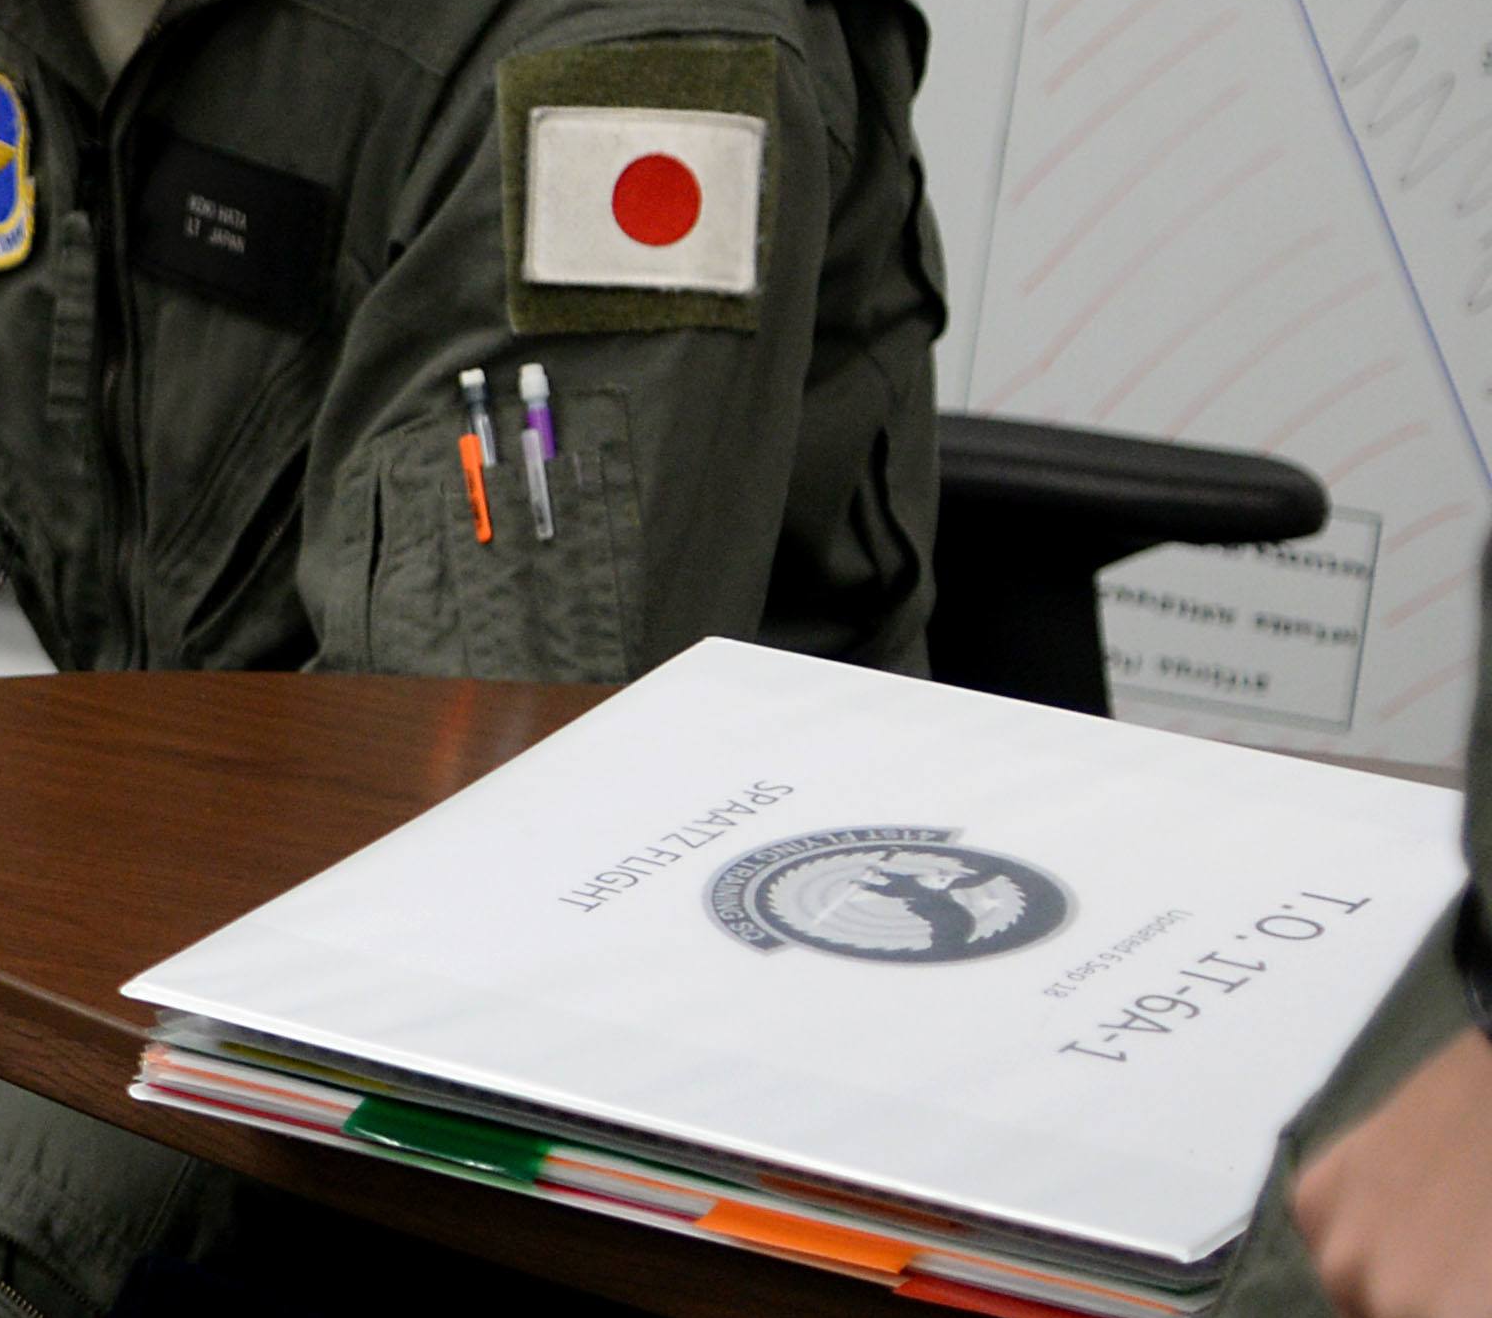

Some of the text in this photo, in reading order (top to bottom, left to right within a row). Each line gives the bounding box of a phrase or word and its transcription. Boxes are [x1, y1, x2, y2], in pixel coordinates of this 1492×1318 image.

[558, 780, 795, 913] SPAATZ FLIGHT
[754, 830, 856, 864] FLYING
[711, 857, 762, 923] TRAINING
[1113, 908, 1194, 956] Updated
[1043, 981, 1077, 999] 18
[1066, 959, 1111, 984] Sep
